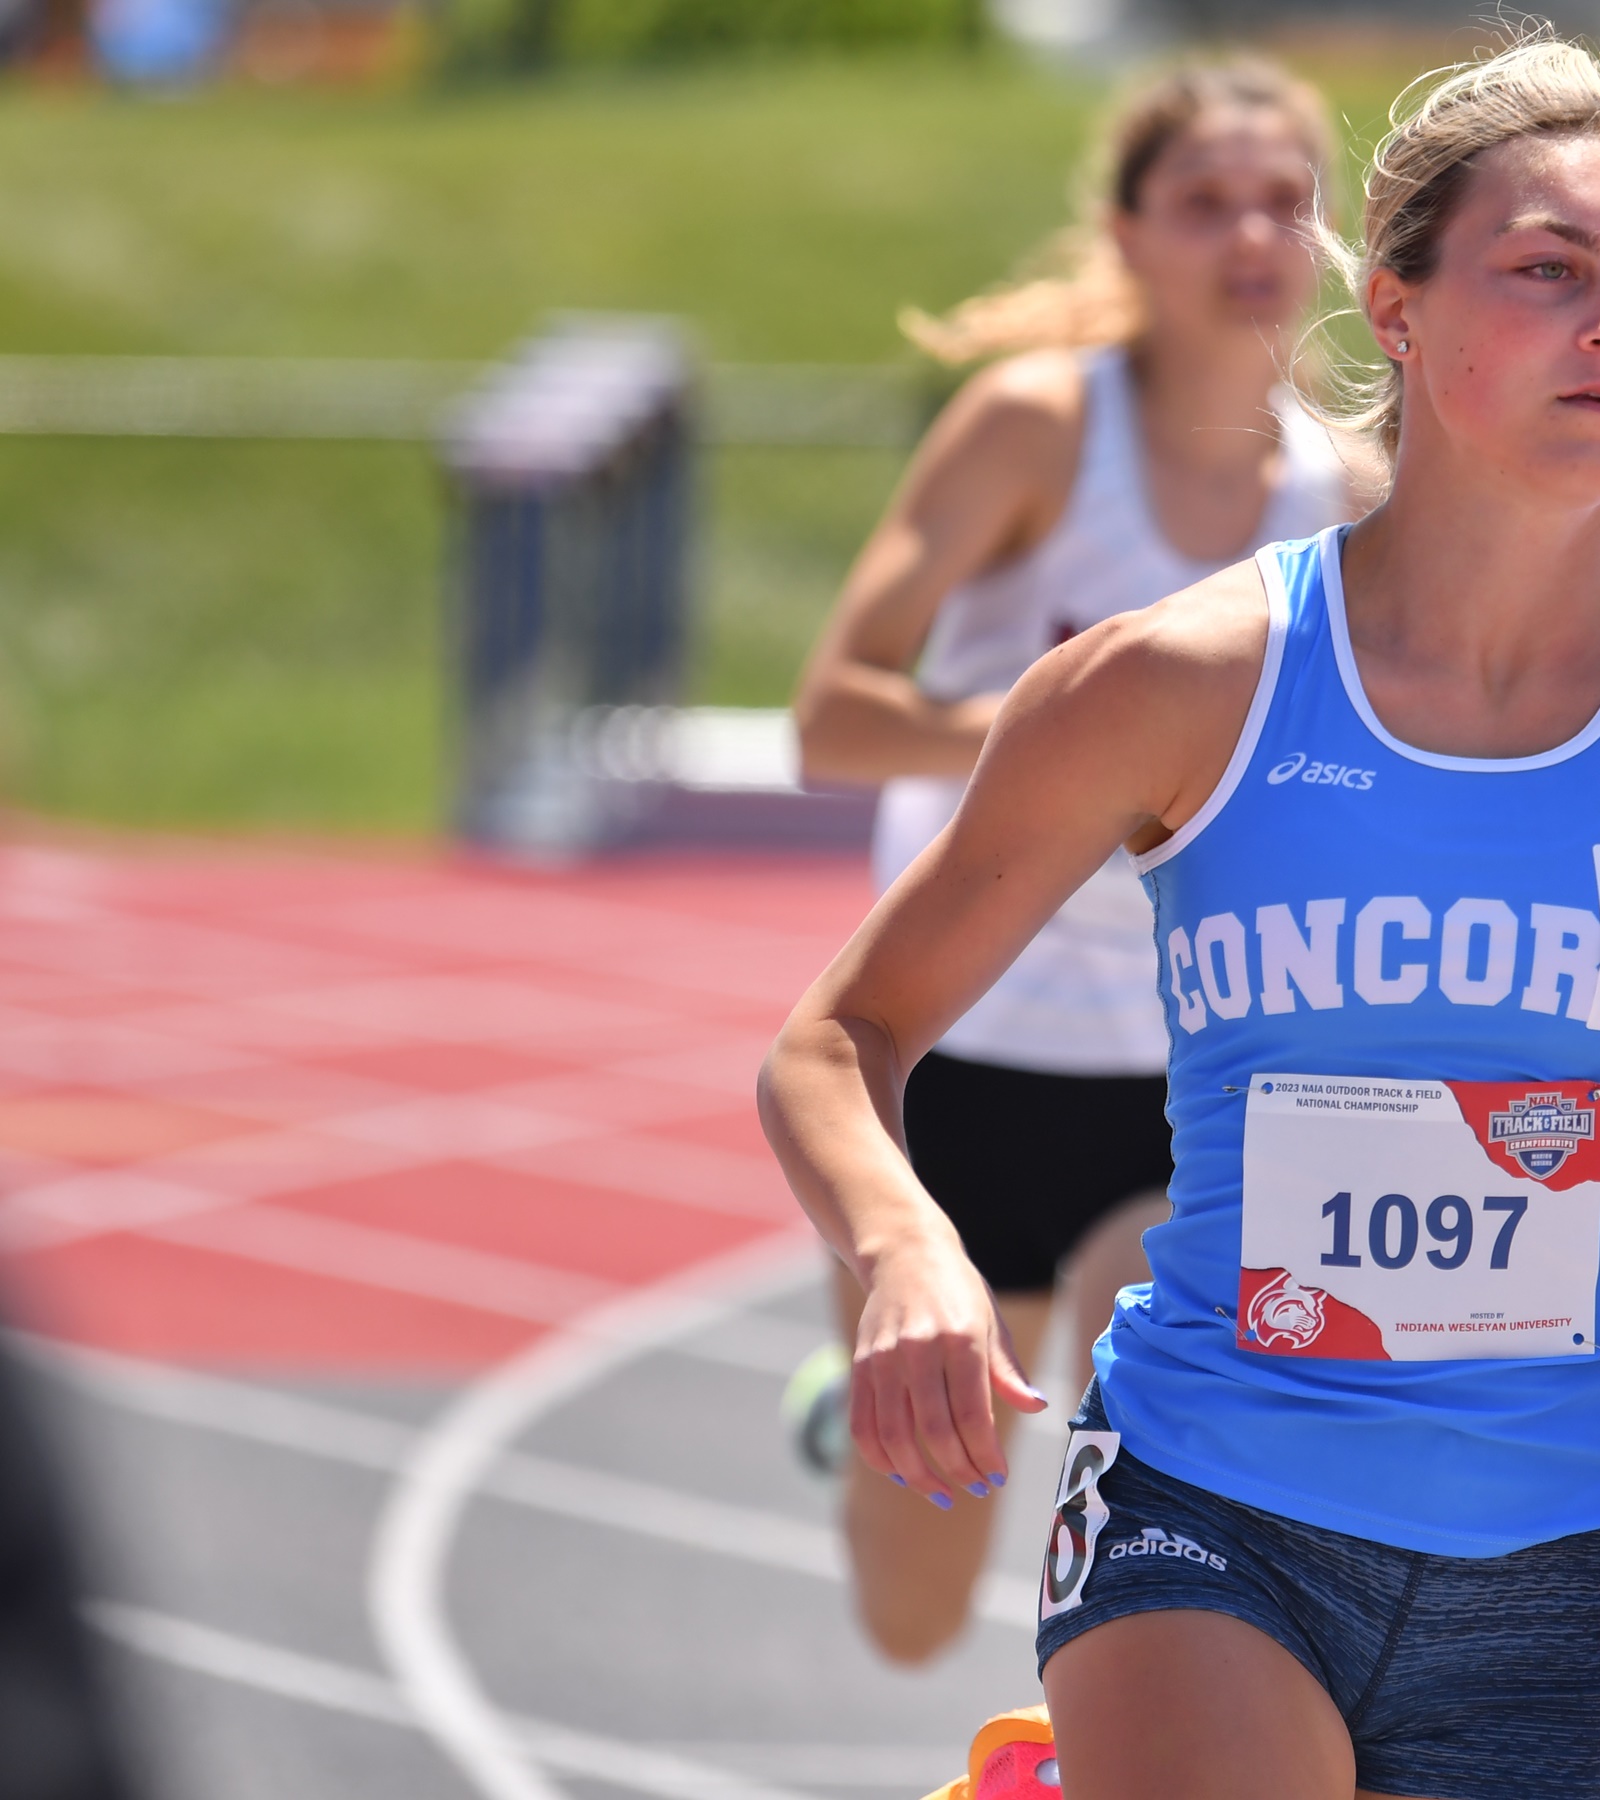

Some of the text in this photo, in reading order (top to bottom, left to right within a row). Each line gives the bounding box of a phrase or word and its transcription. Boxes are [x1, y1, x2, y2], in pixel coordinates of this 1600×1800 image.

[1301, 761, 1377, 790] asics
[1275, 1083, 1442, 1100] 2023 NAIA OUTDOOR TRACK & FIELD
[1296, 1098, 1419, 1113] NATIONAL CHAMPIONSHIP
[1529, 1095, 1559, 1108] NAIA
[1510, 1139, 1573, 1150] CHAMPIONSHIPS
[1320, 1191, 1529, 1270] 1097
[1395, 1317, 1572, 1332] INDIANA WESLEYAN UNIVERSITY
[1108, 1536, 1228, 1572] adidas
